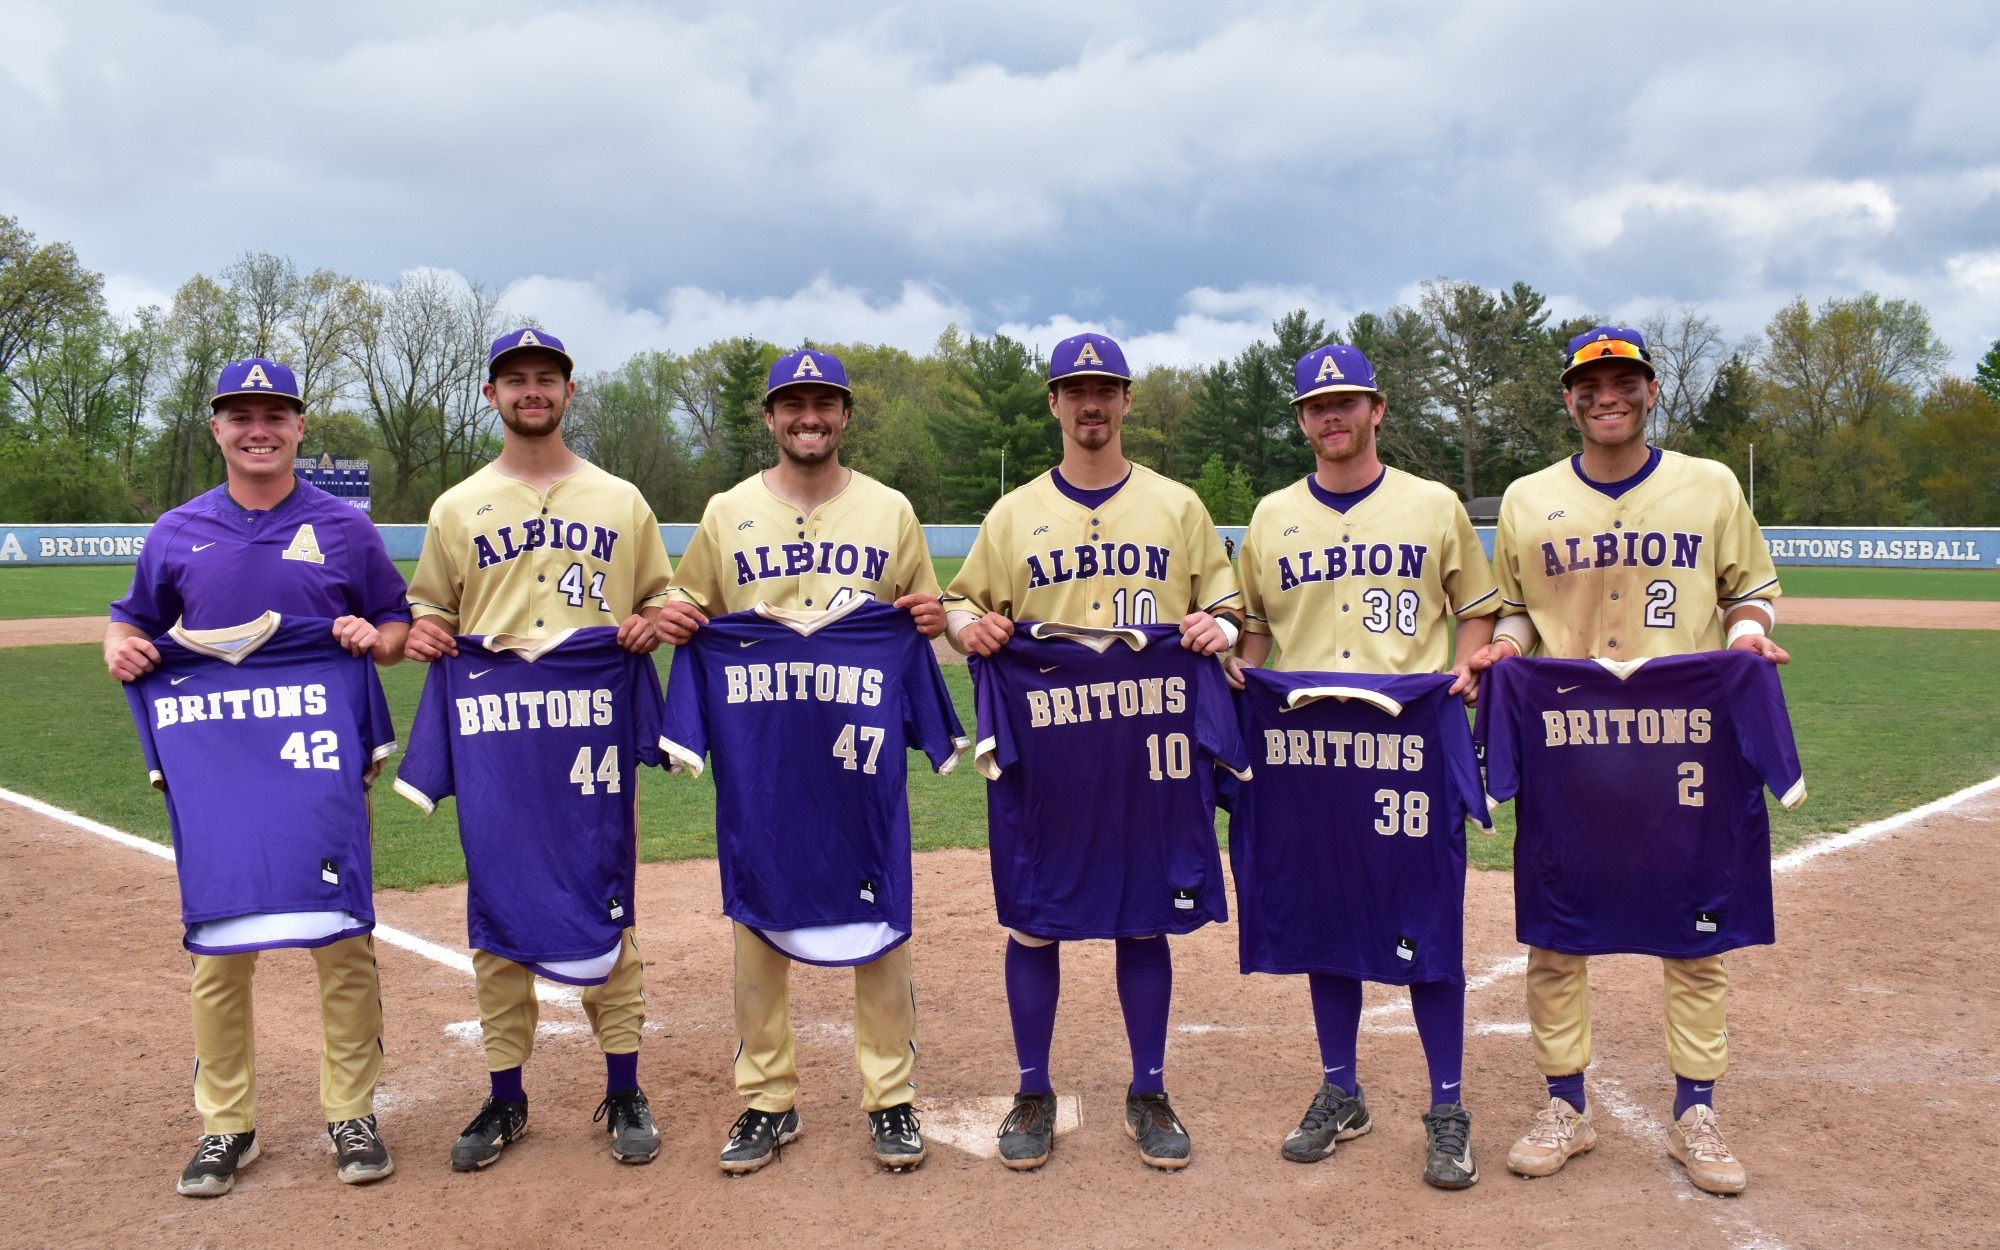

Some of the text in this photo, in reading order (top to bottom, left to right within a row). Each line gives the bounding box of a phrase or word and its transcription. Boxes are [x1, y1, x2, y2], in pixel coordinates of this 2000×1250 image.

[518, 331, 541, 346] A
[1074, 343, 1103, 367] A
[241, 365, 273, 388] A
[793, 355, 822, 378] A
[1315, 356, 1344, 383] A
[294, 459, 317, 468] BION
[335, 460, 368, 469] COLLEGE
[0, 532, 146, 560] A BRITONS
[282, 524, 326, 565] A
[473, 517, 619, 570] ALBION
[733, 540, 890, 586] ALBION
[1026, 541, 1171, 590] ALBION
[1541, 531, 1703, 578] ALBION
[1766, 539, 1853, 559] RITONS
[1858, 540, 1980, 561] BASEBALL
[1277, 543, 1428, 593] ALBION
[1113, 588, 1158, 628] 10
[1362, 587, 1420, 636] 38
[1644, 579, 1677, 629] 2
[154, 684, 327, 729] BRITONS
[724, 662, 883, 707] BRITONS
[1027, 676, 1186, 728] BRITONS
[456, 689, 613, 735] BRITONS
[1542, 709, 1712, 747] BRITONS
[280, 730, 340, 770] 42
[569, 745, 621, 795] 44
[833, 724, 885, 775] 47
[1146, 732, 1191, 780] 10
[1264, 729, 1424, 772] BRITONS
[1677, 762, 1704, 807] 2
[1374, 788, 1429, 838] 38
[1180, 890, 1187, 898] L
[1702, 913, 1710, 921] L
[1402, 939, 1408, 948] L
